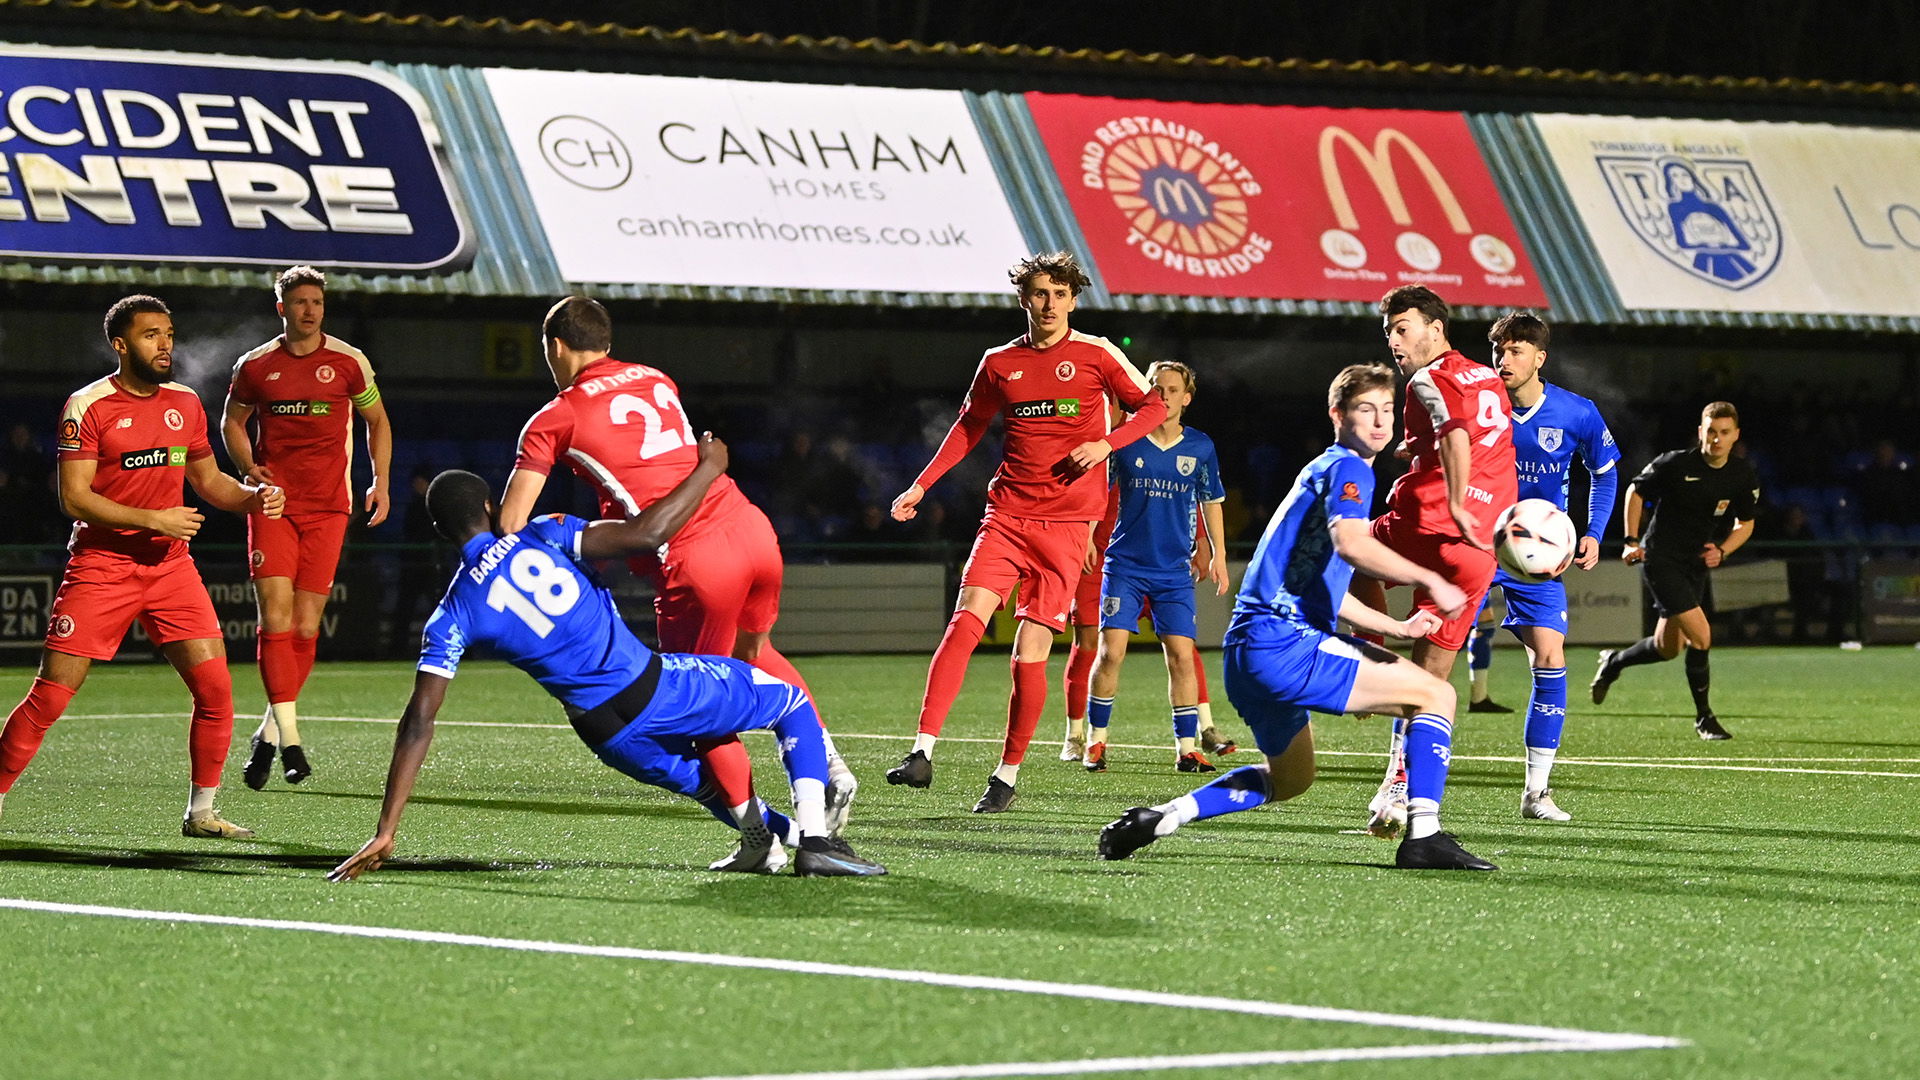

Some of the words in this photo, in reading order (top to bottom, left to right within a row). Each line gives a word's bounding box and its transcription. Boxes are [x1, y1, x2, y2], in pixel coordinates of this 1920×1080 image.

[0, 84, 370, 159] CIDENT
[658, 121, 968, 175] CANHAM
[1081, 140, 1105, 190] DMD
[1094, 115, 1263, 198] RESTAURANTS
[769, 177, 887, 201] HOMES
[616, 214, 972, 249] canhamhomes.co.uk
[1124, 226, 1273, 279] TONBRIDGE
[581, 379, 607, 397] DI
[271, 401, 308, 414] confr
[311, 404, 329, 414] ex
[1015, 401, 1053, 416] confr
[1058, 403, 1077, 414] ex
[1476, 389, 1509, 448] 9
[124, 449, 167, 468] confr
[170, 452, 186, 463] ex
[1515, 461, 1561, 474] NHAM
[1518, 474, 1539, 484] MES
[1465, 485, 1494, 505] TRM
[486, 547, 581, 640] 18
